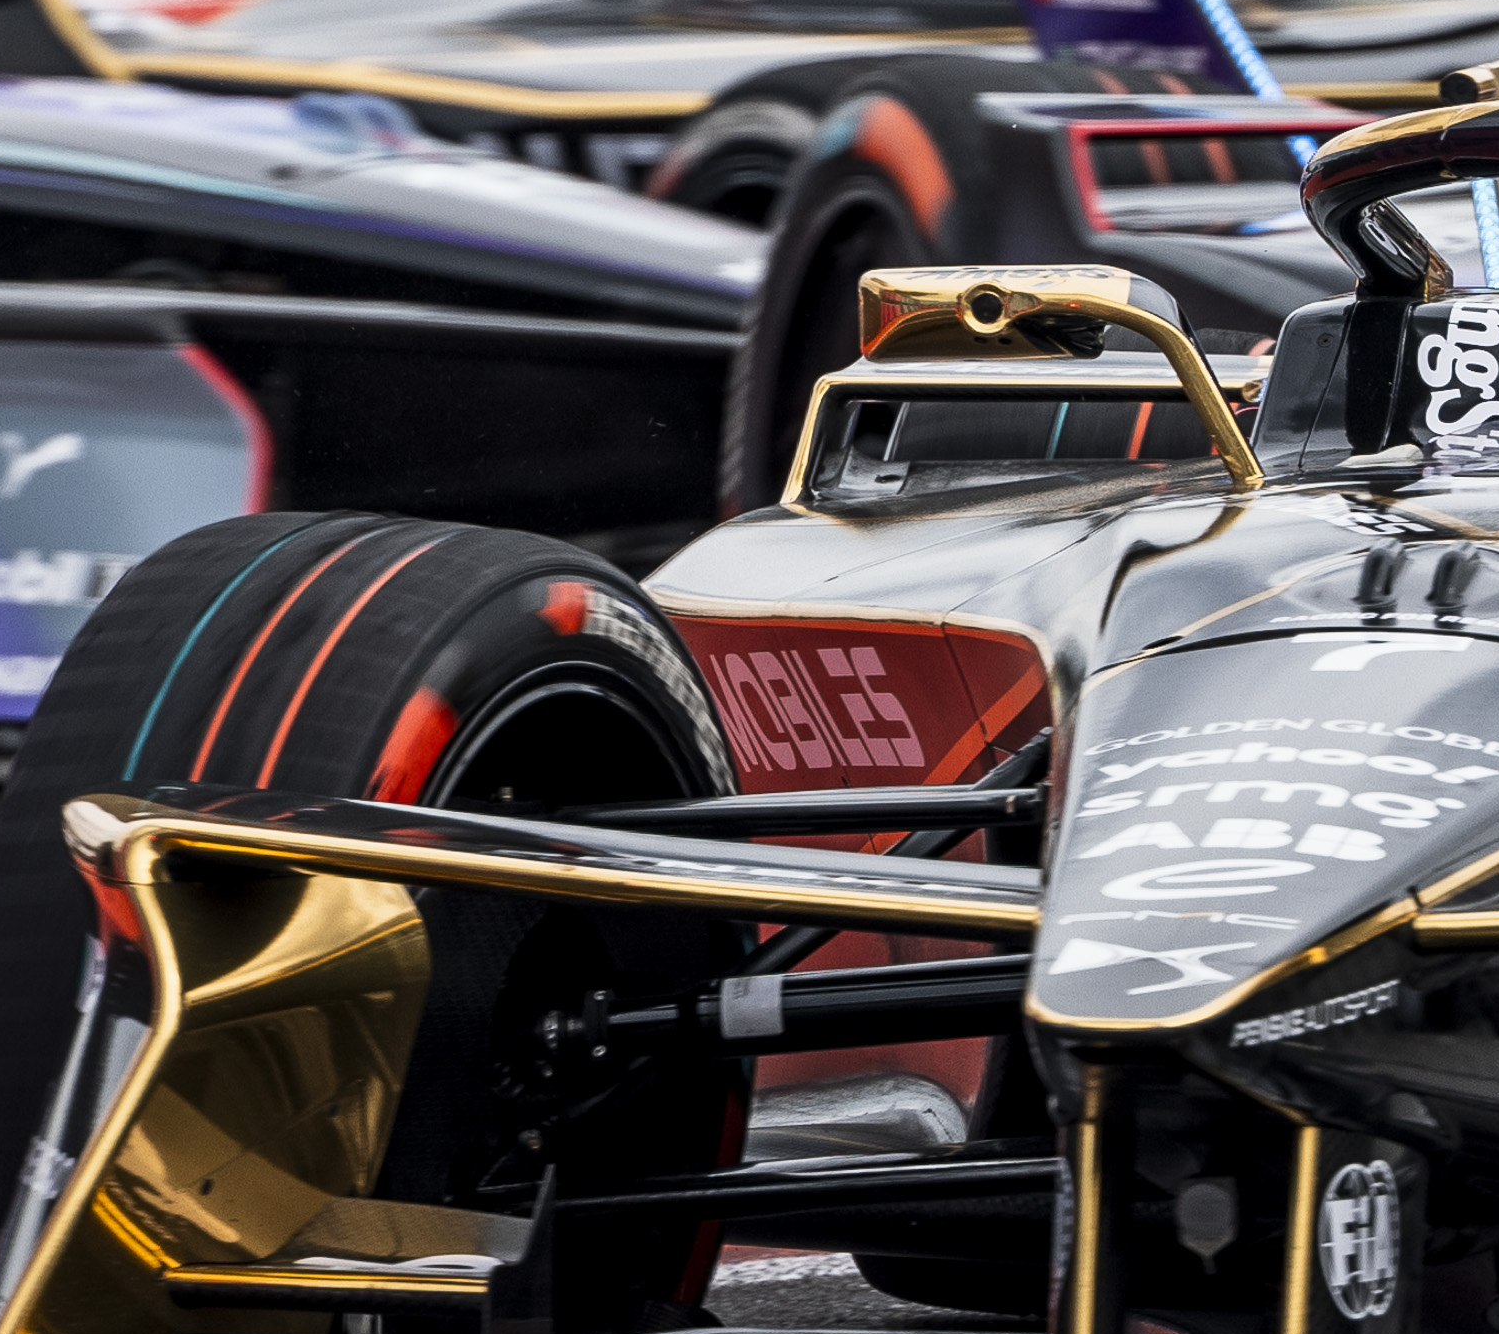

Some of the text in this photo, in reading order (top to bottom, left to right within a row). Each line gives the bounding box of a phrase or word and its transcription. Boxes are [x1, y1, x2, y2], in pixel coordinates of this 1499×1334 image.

[1291, 631, 1474, 671] 7
[1082, 717, 1314, 756] GOLDEN
[1073, 817, 1388, 863] ABB
